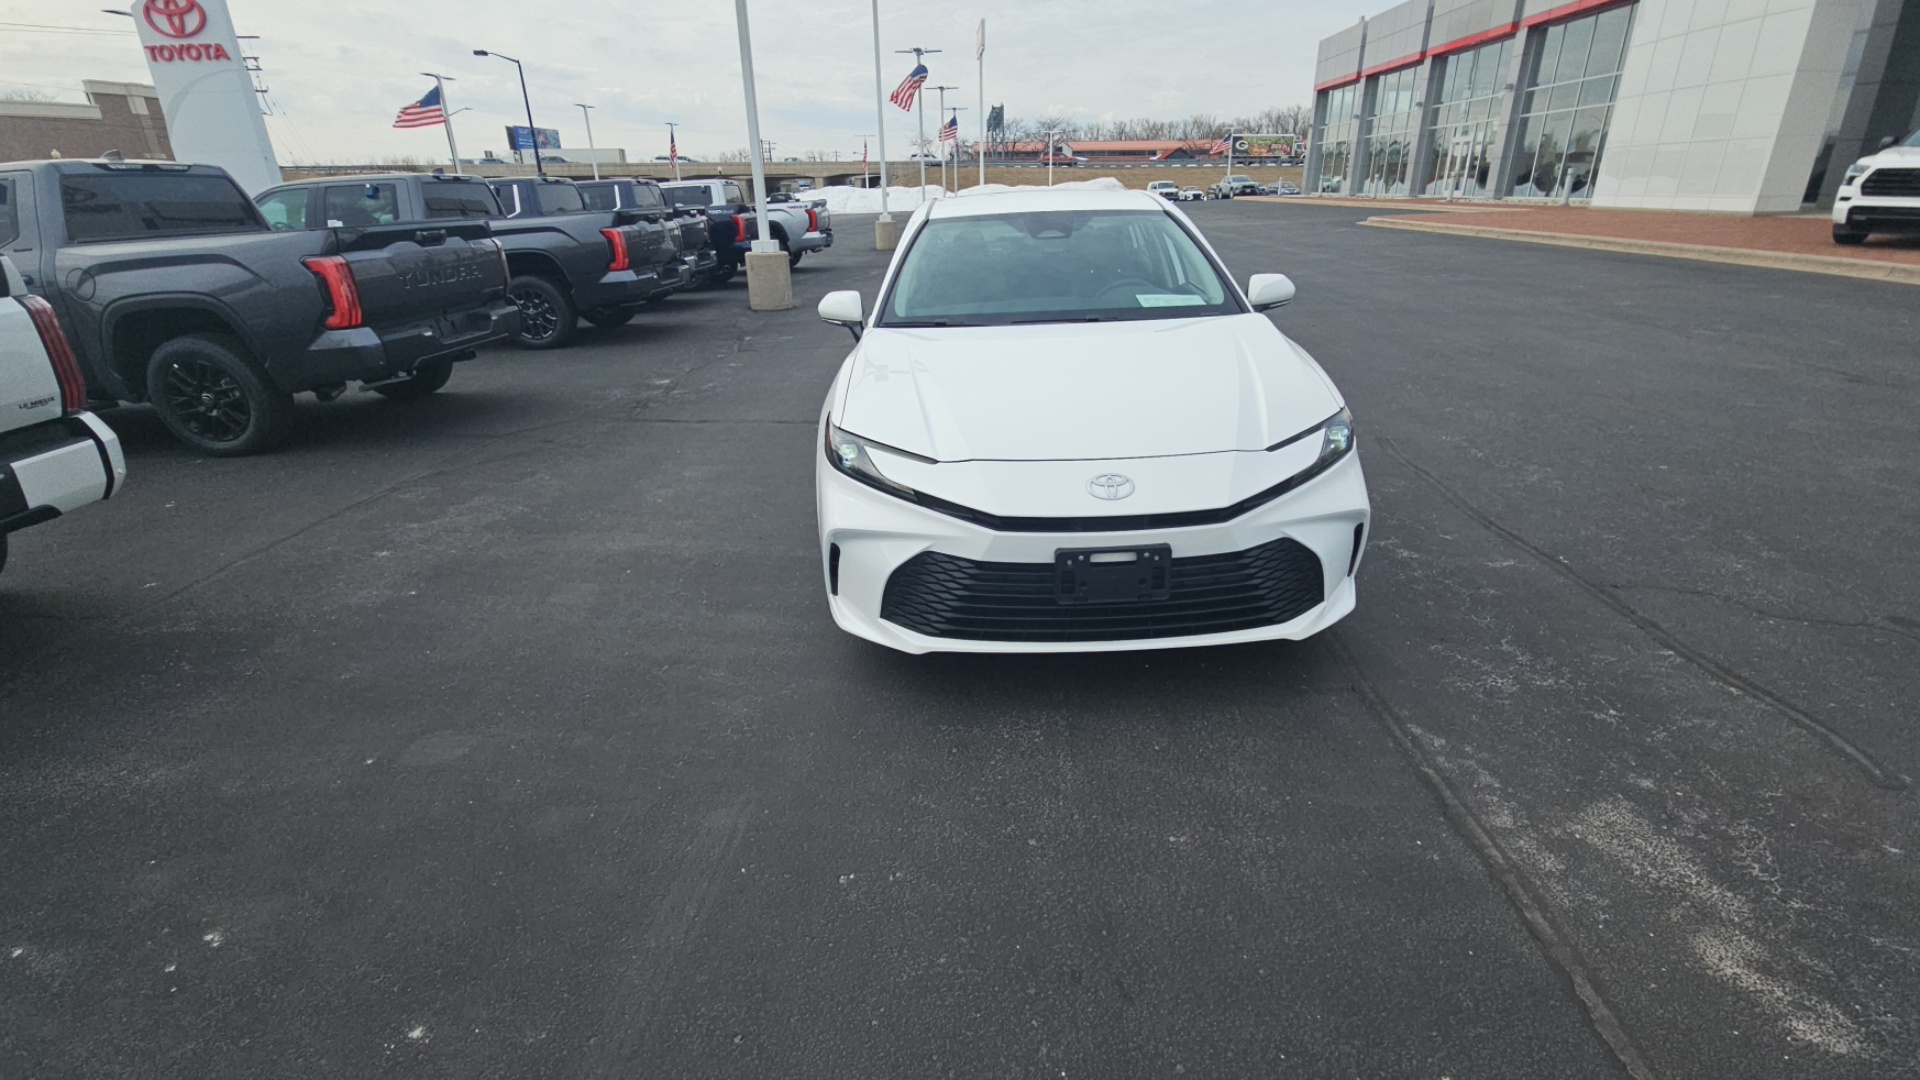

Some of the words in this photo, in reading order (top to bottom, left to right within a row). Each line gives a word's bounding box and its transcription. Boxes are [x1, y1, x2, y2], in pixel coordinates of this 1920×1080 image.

[144, 43, 231, 62] TOYOTA
[1235, 140, 1249, 150] G
[398, 264, 483, 289] TUNDRA
